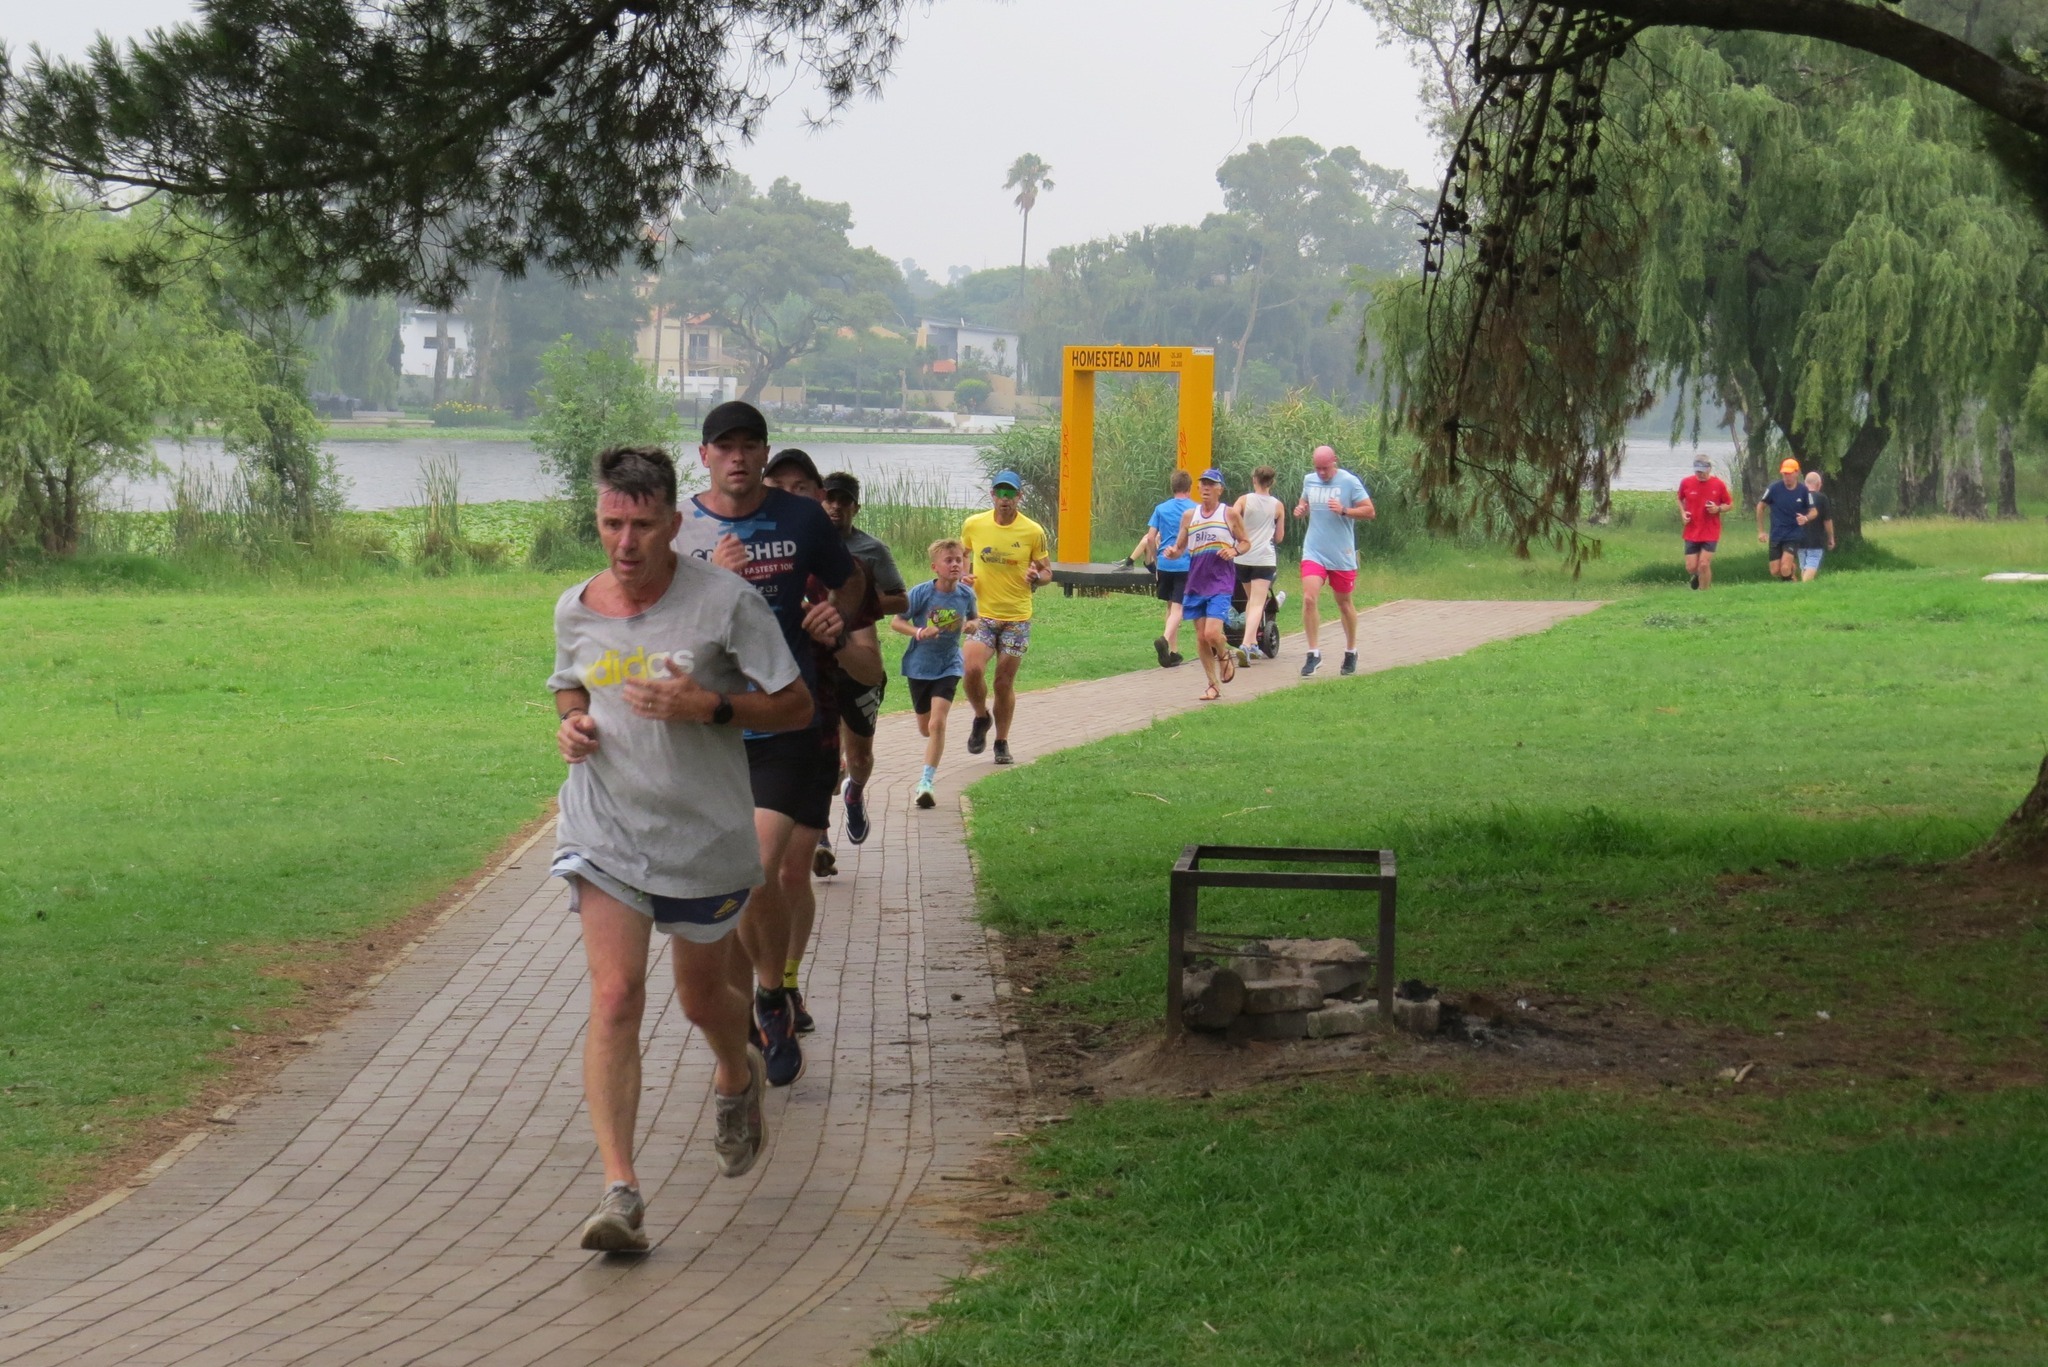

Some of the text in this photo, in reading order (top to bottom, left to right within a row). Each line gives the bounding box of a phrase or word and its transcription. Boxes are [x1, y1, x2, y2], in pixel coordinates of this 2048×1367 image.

[1072, 350, 1134, 367] HOMESTEAD
[1138, 351, 1160, 368] DAM
[745, 564, 778, 575] FASTEST
[780, 562, 794, 571] 10K
[586, 646, 695, 688] didas
